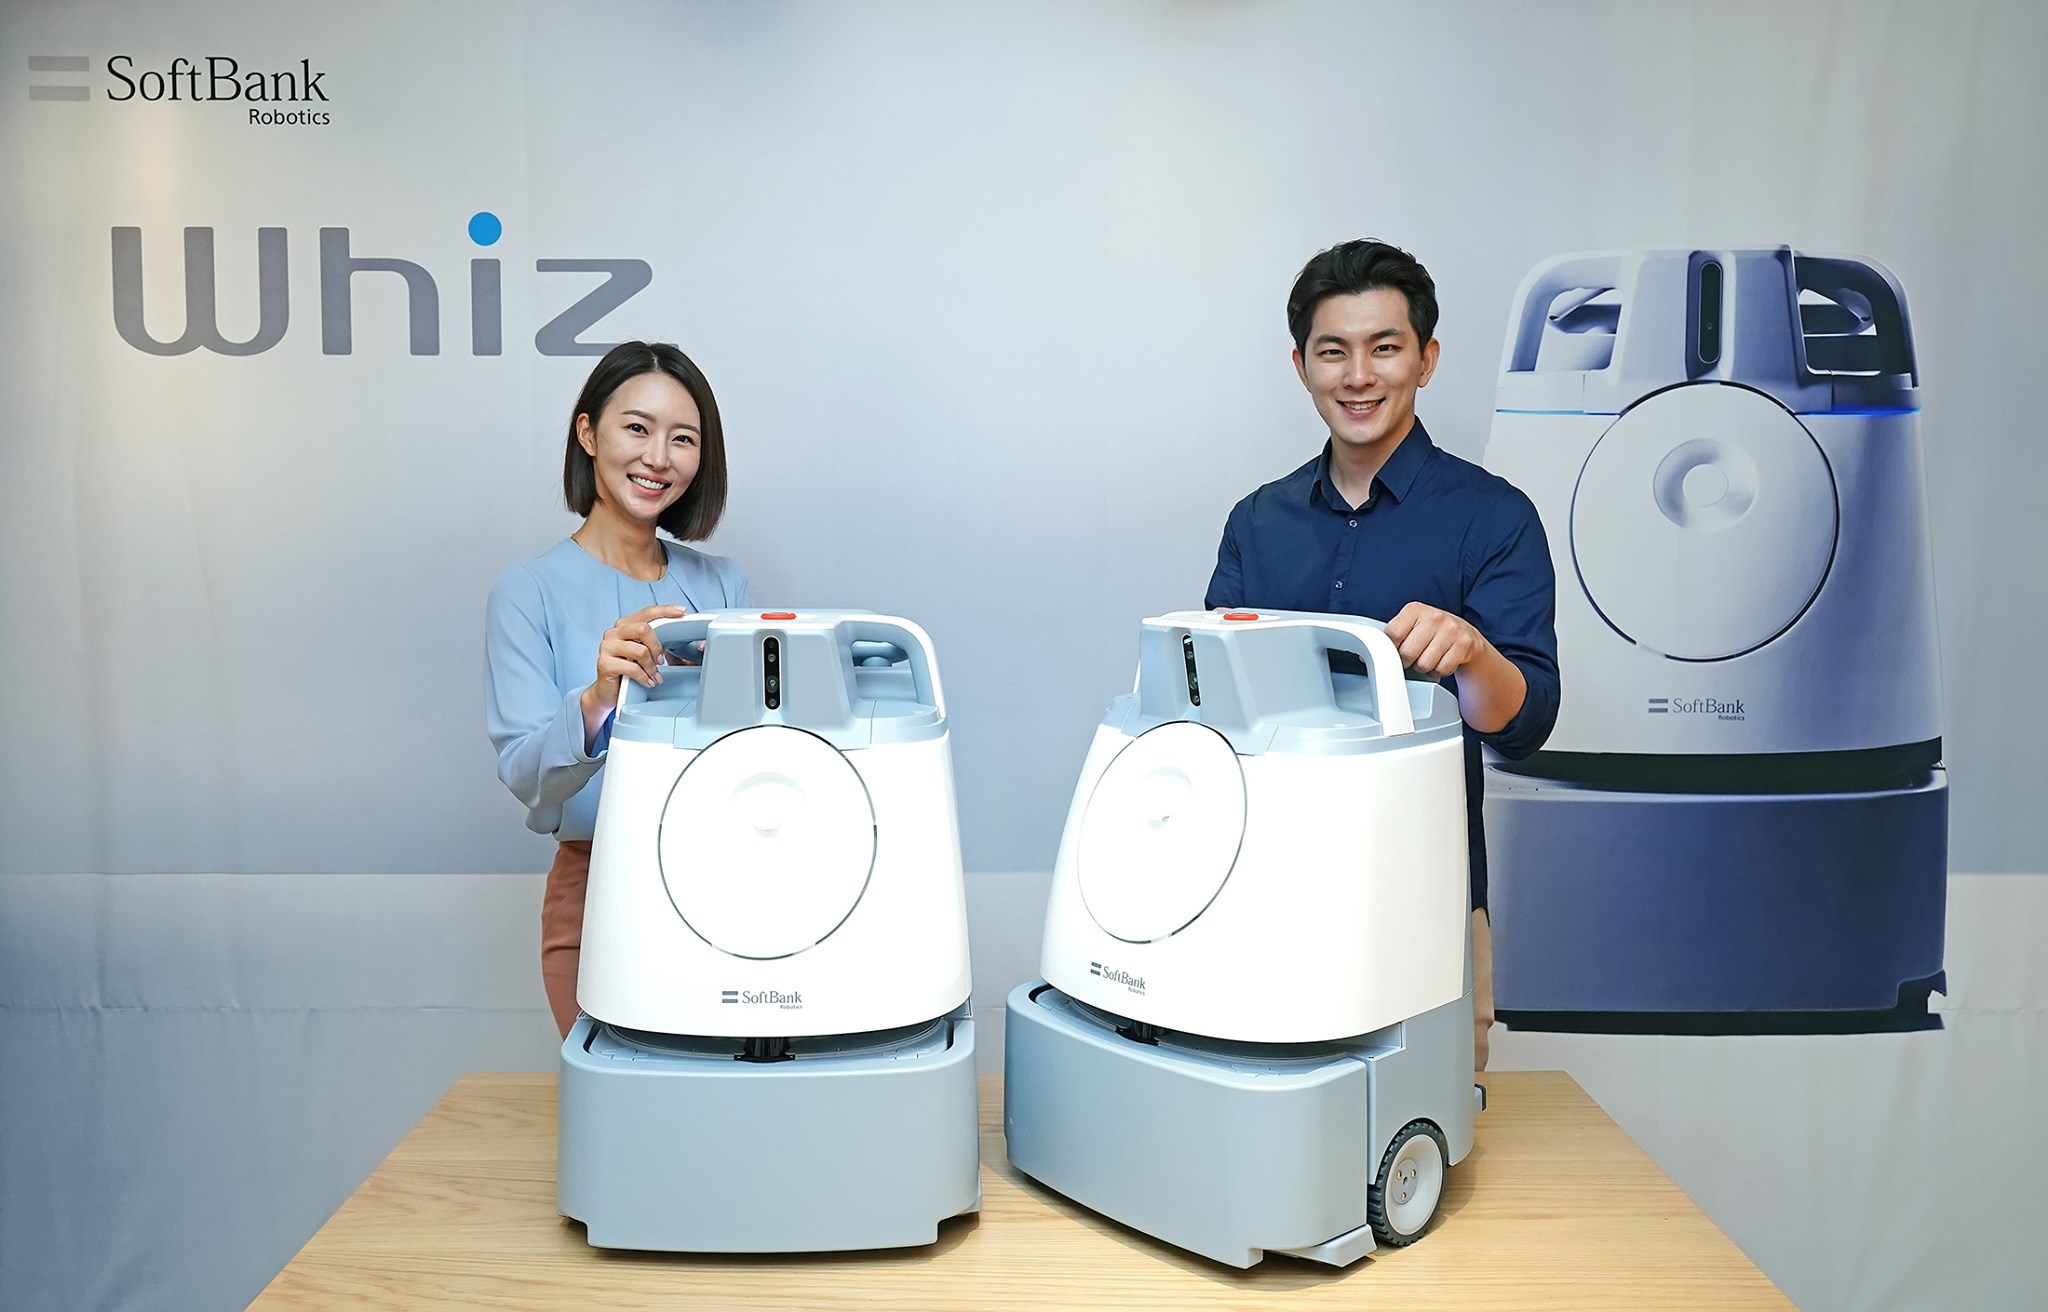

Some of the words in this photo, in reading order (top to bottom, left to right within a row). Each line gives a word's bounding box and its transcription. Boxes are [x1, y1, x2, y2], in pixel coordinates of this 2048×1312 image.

[106, 55, 330, 101] SoftBank
[248, 108, 331, 126] Robotics
[111, 211, 680, 357] Whiz
[1672, 697, 1745, 714] SoftBank
[1102, 965, 1146, 990] SoftBank
[741, 990, 802, 1004] SoftBank
